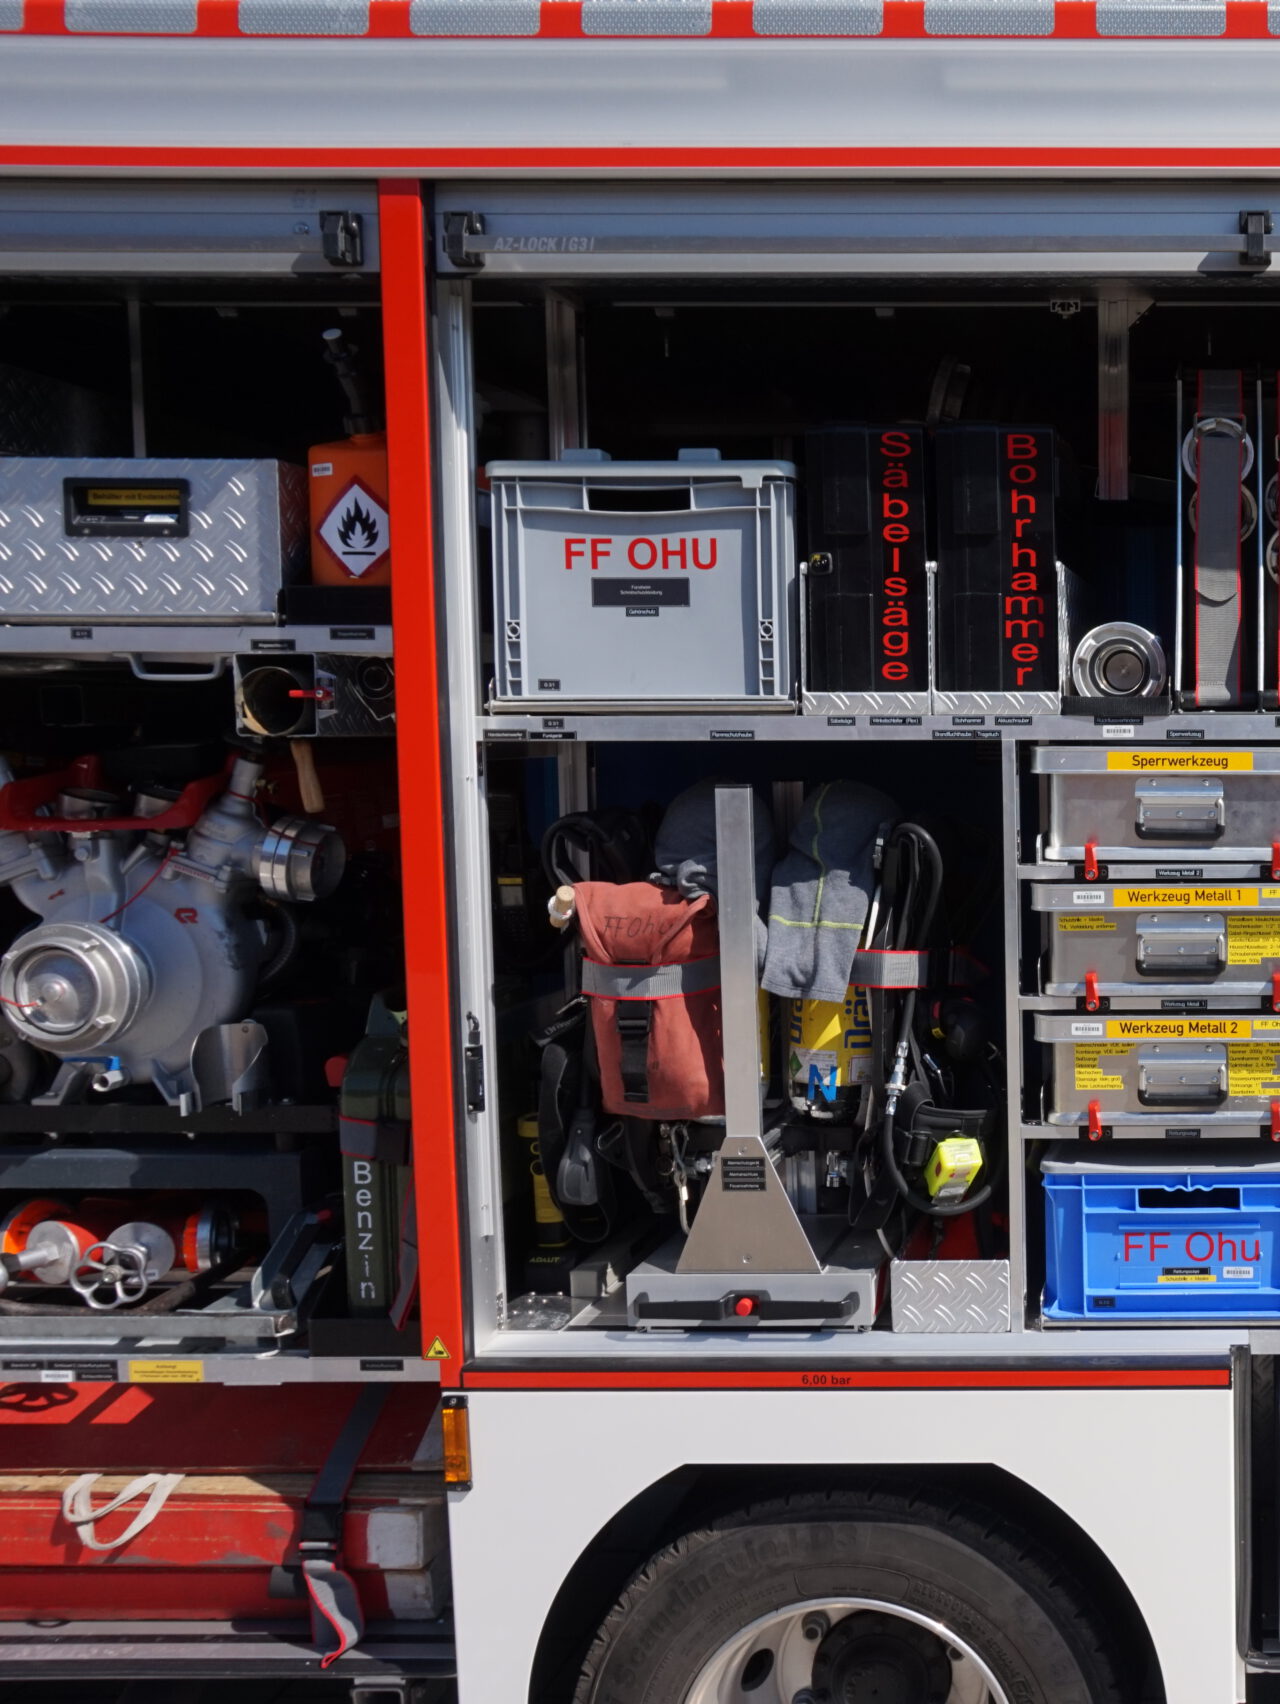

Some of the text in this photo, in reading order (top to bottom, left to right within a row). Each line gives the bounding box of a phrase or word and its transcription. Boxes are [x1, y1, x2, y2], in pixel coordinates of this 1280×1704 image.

[494, 236, 557, 251] AZ-LOCK
[564, 537, 718, 571] FF OHU
[880, 431, 912, 681] Säbelsäge
[1004, 434, 1044, 686] Bohrhammer
[1131, 755, 1229, 770] Sperrwerkzeug
[1127, 889, 1241, 904] Werkzeug Metall 1
[1119, 1021, 1238, 1036] Werkzeug Metall 2
[353, 1160, 376, 1301] Benzin
[1123, 1231, 1261, 1262] FF Ohu
[802, 1375, 852, 1386] 6,00 bar
